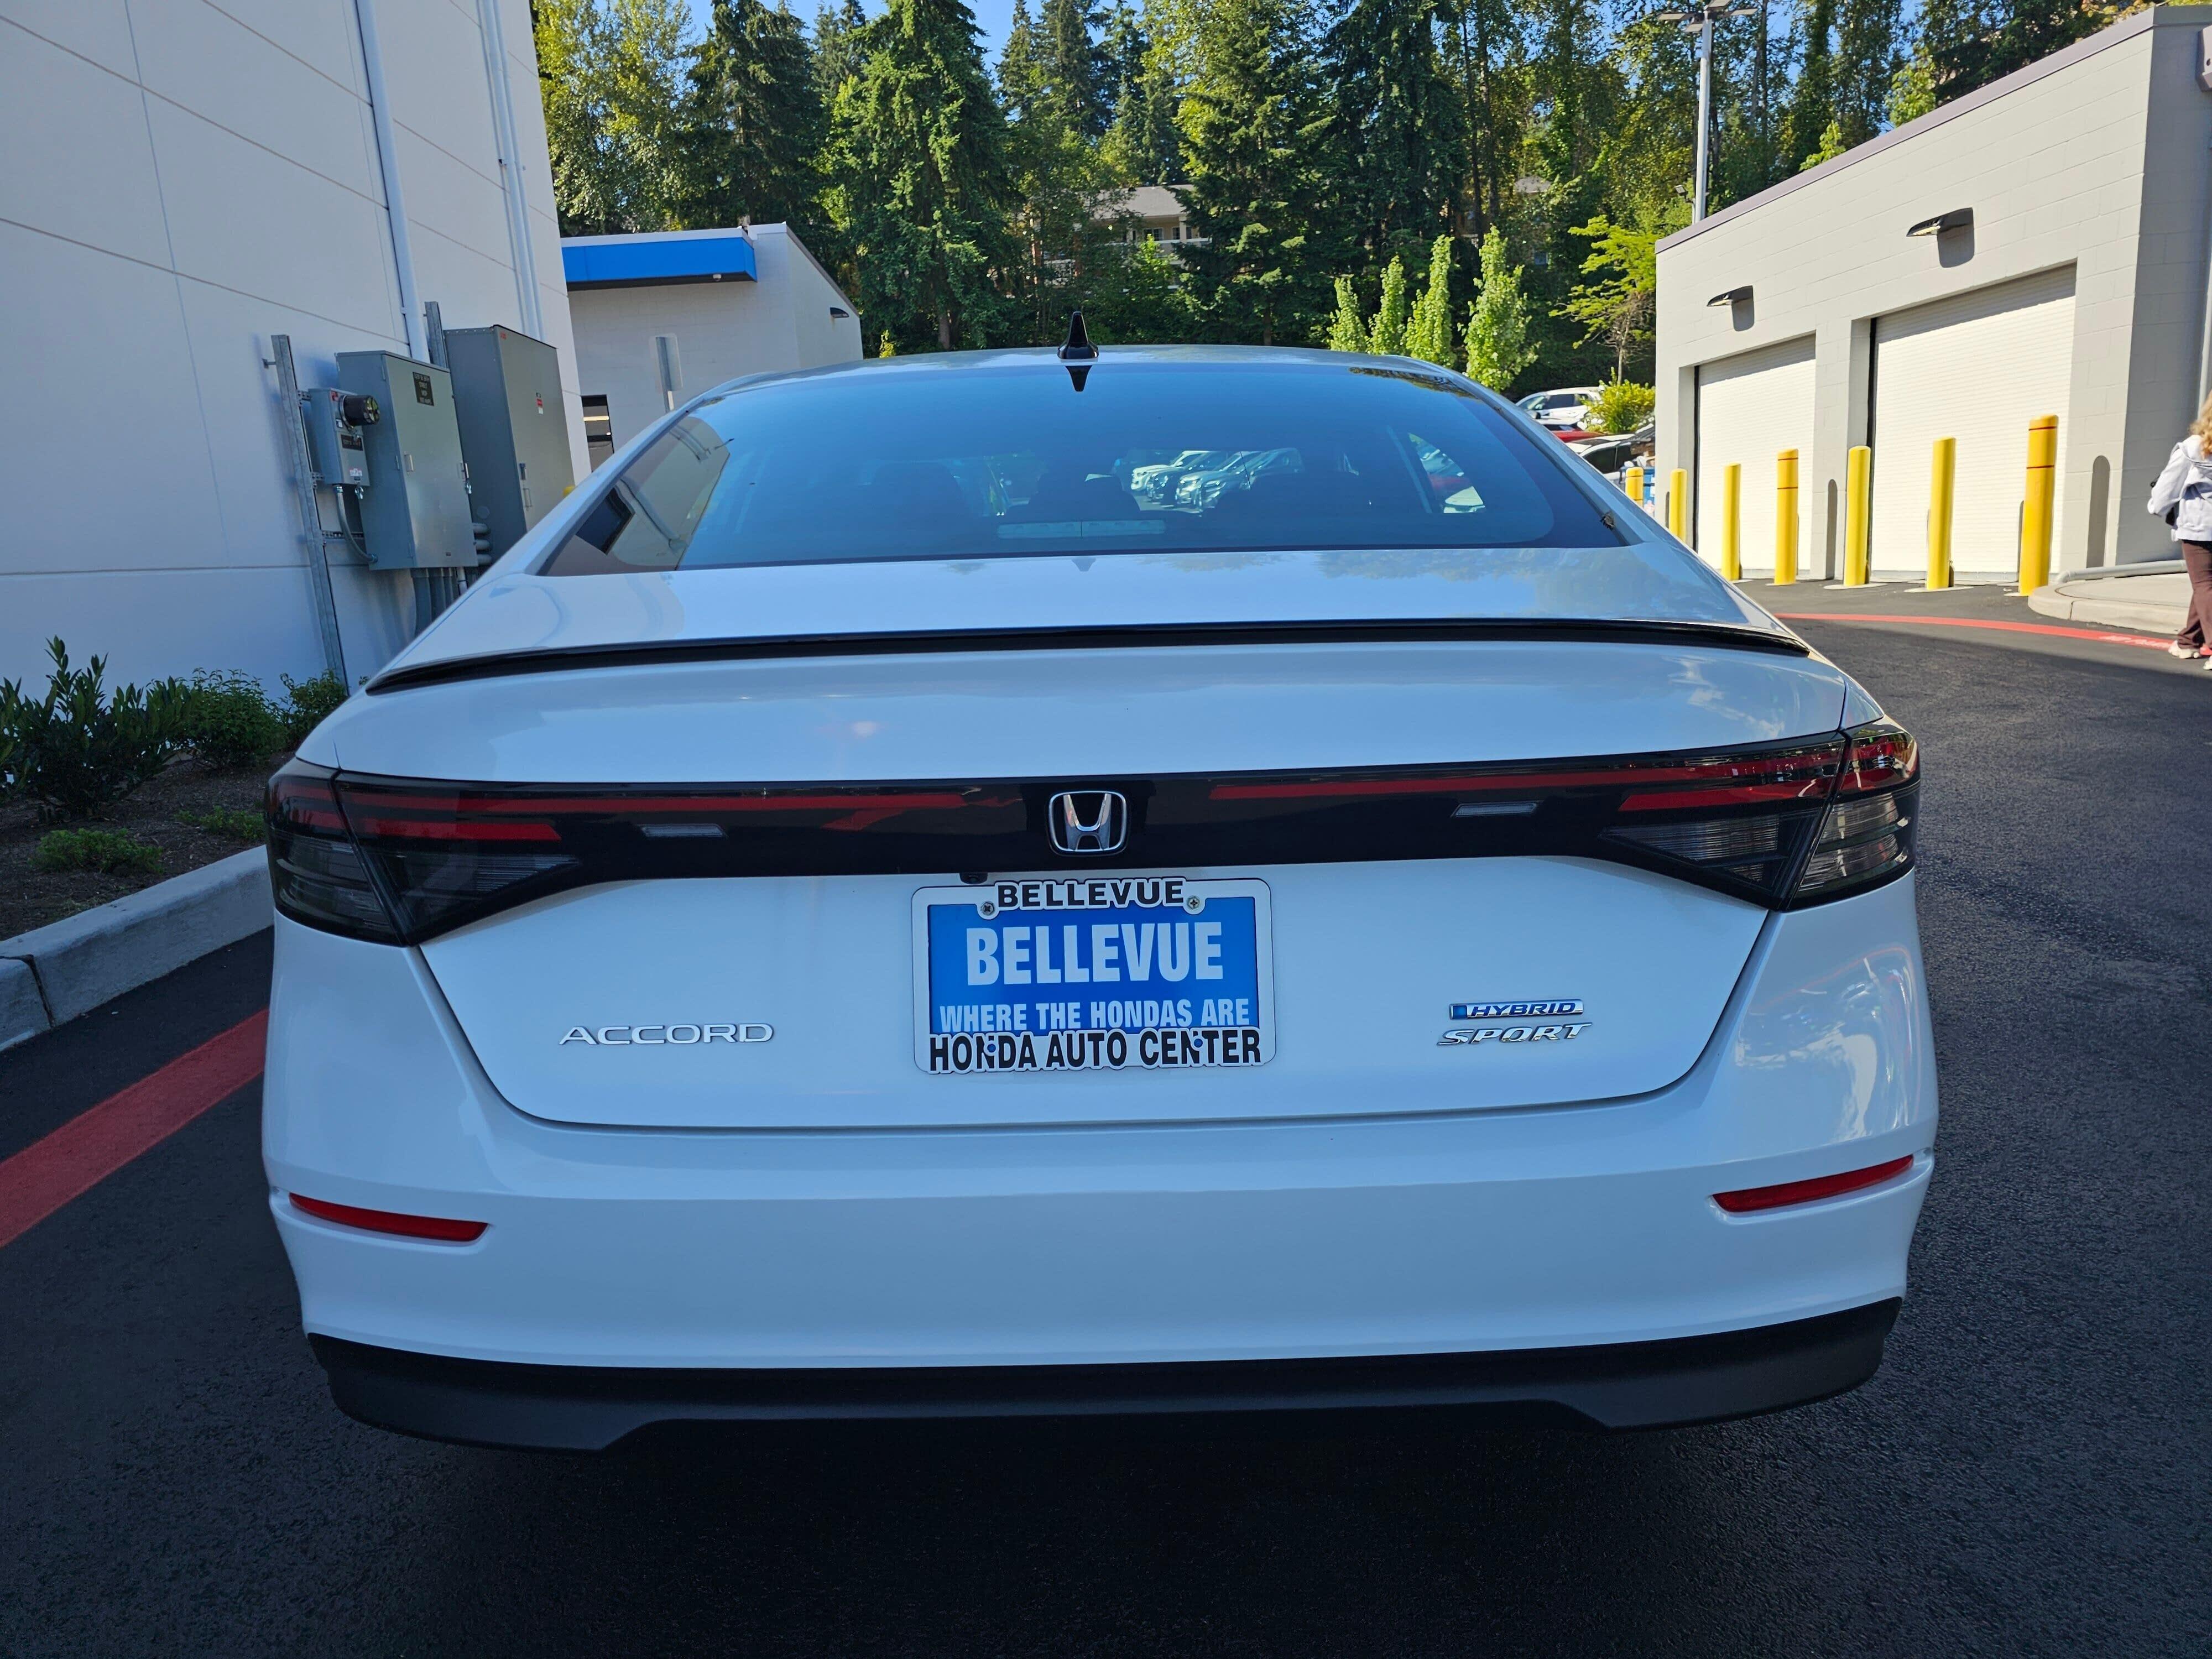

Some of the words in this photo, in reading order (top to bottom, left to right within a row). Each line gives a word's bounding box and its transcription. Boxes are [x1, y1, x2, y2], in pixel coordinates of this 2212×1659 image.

[997, 880, 1184, 908] BELLEVUE
[966, 921, 1224, 986] BELLEVUE
[940, 1004, 1027, 1033] WHERE
[1035, 1002, 1081, 1030] THE
[1091, 999, 1193, 1028] HONDAS
[1201, 998, 1250, 1026] ARE
[1470, 1002, 1576, 1017] HYBRID
[559, 1022, 774, 1046] ACCORD
[1436, 1022, 1593, 1046] SPORT
[930, 1034, 1037, 1072] HONDA
[1046, 1031, 1127, 1067] AUTO
[1139, 1029, 1261, 1066] CENTER
